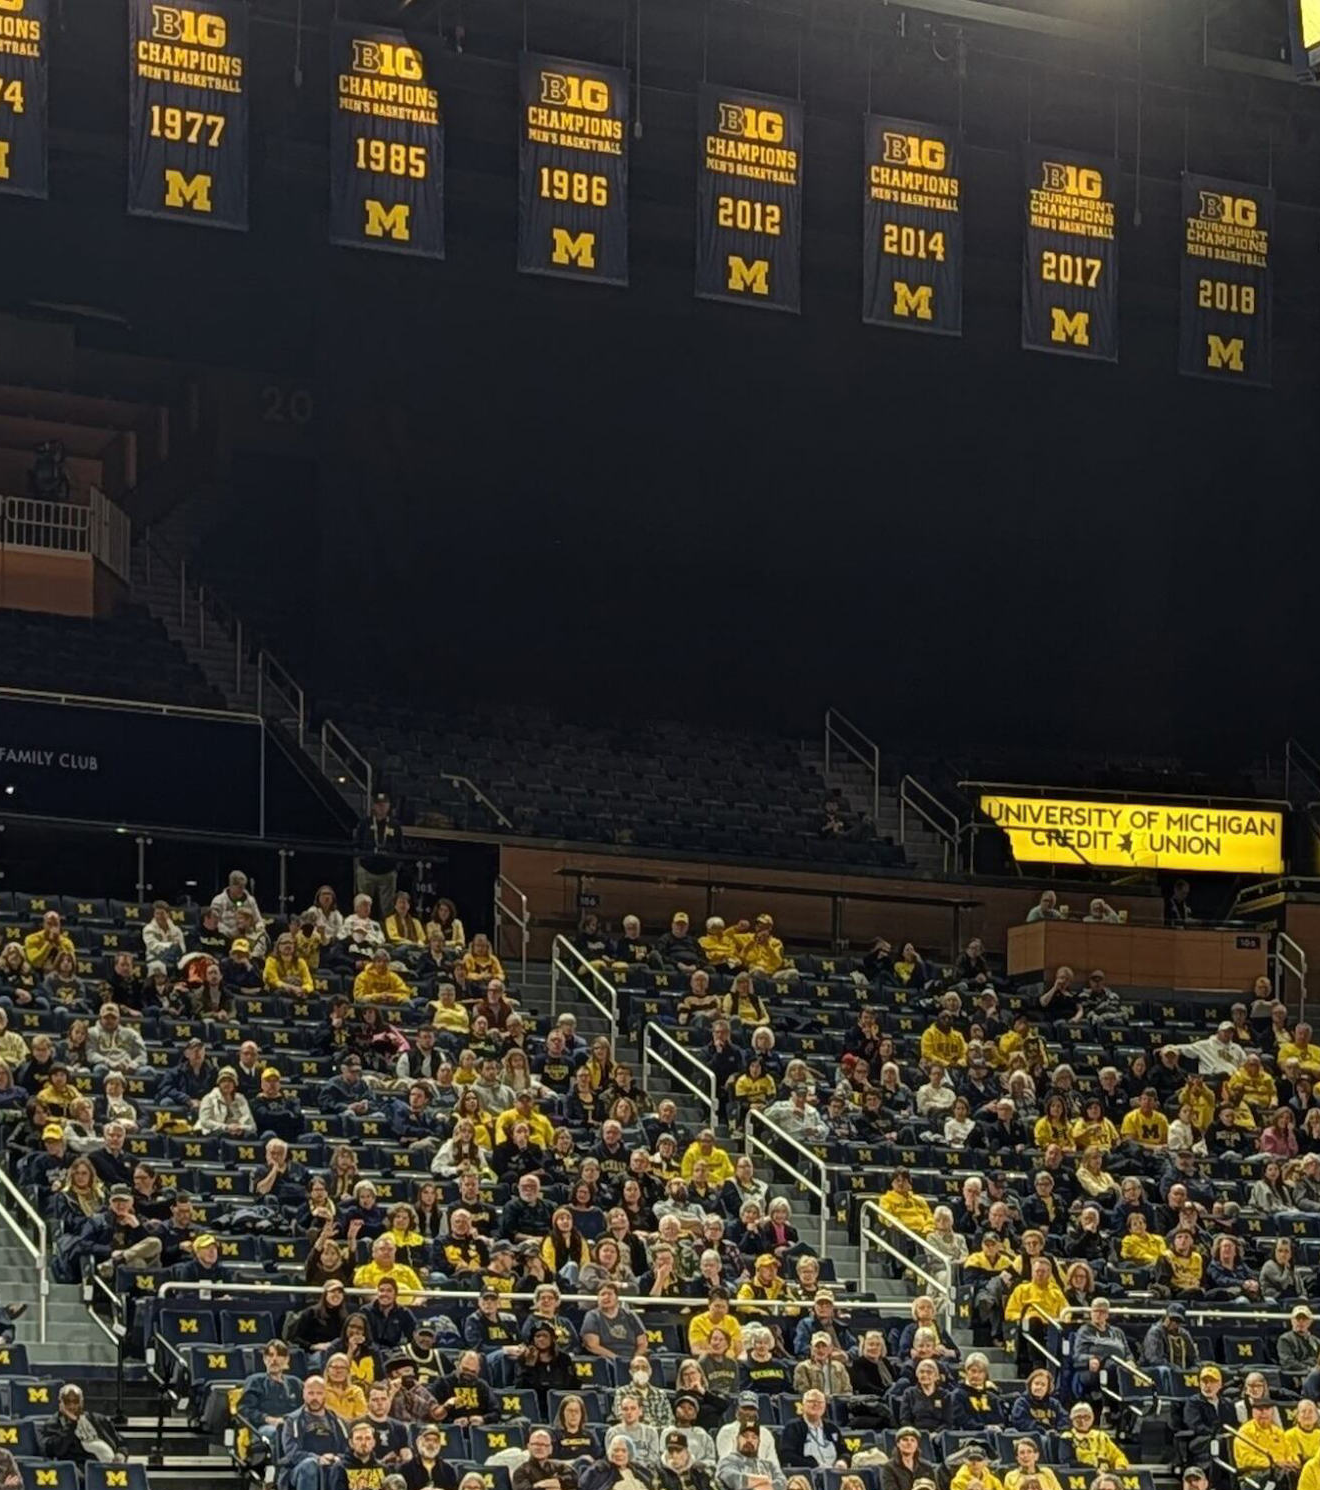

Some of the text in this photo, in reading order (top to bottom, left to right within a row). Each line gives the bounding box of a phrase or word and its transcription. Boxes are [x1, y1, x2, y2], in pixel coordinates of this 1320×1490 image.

[137, 40, 242, 77] CHAMPIONS
[172, 70, 242, 93] BASKETBALL
[338, 73, 439, 109] CHAMPIONS
[150, 105, 226, 147] 1977
[338, 95, 439, 125] MEN'S BASKETBALL
[527, 104, 623, 140] CHAMPIONS
[355, 136, 426, 179] 1985
[559, 132, 622, 156] BASKETBALL
[705, 134, 797, 171] CHAMPIONS
[164, 168, 212, 212] M
[540, 166, 608, 208] 1986
[737, 161, 797, 186] BASKETBALL
[870, 164, 959, 198] CHAMPIONS
[364, 198, 410, 242] M
[718, 195, 781, 236] 2012
[900, 190, 959, 213] BASKETBALL
[1029, 199, 1115, 227] CHAMPIONS
[552, 226, 596, 269] M
[883, 222, 945, 262] 2014
[1186, 226, 1269, 254] CHAMPIONS
[727, 254, 770, 296] M
[1042, 250, 1102, 289] 2017
[892, 280, 933, 320] M
[1198, 278, 1255, 315] 2018
[1050, 306, 1090, 347] M
[1206, 333, 1245, 372] M
[59, 752, 98, 771] CLUB
[986, 802, 1276, 836] UNIVERSITY OF MICHIGAN
[1031, 830, 1221, 856] CREDIT UNION
[28, 1388, 50, 1404] M
